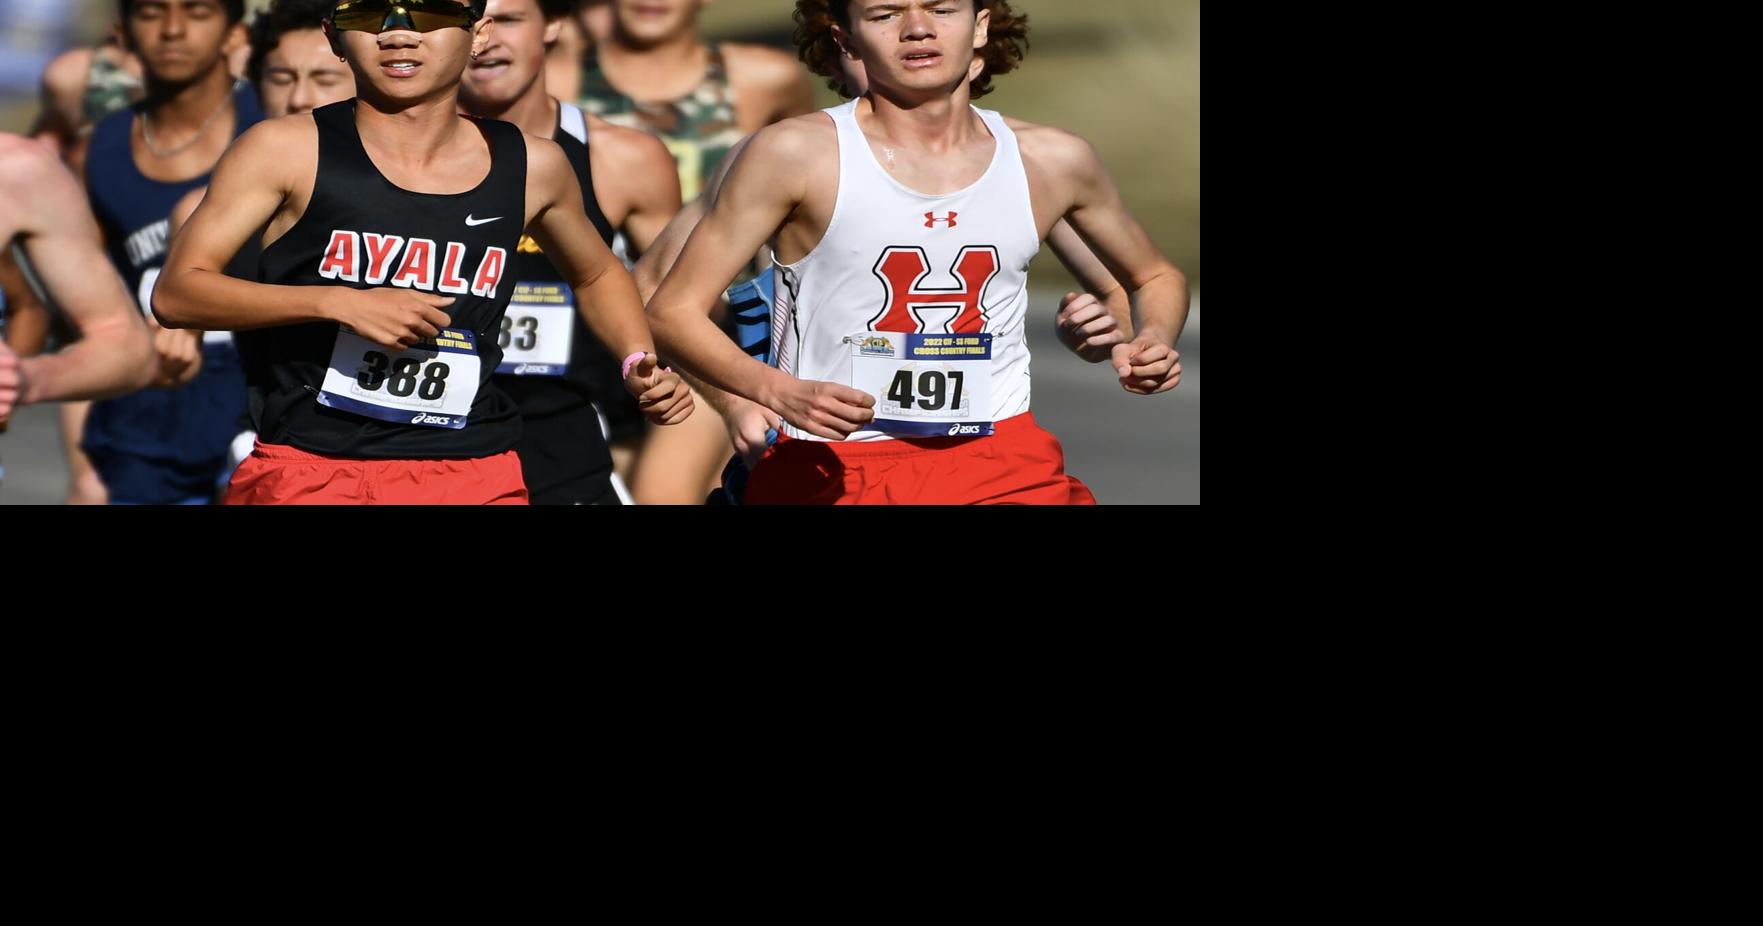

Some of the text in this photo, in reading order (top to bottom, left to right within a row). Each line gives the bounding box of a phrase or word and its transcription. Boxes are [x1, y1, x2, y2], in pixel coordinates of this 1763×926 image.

[318, 230, 507, 299] AYALA
[867, 245, 1001, 334] H
[913, 346, 986, 355] CROSS COUNTRY FINALS
[923, 338, 943, 346] 2022
[357, 350, 450, 400] 388
[887, 370, 964, 411] 497
